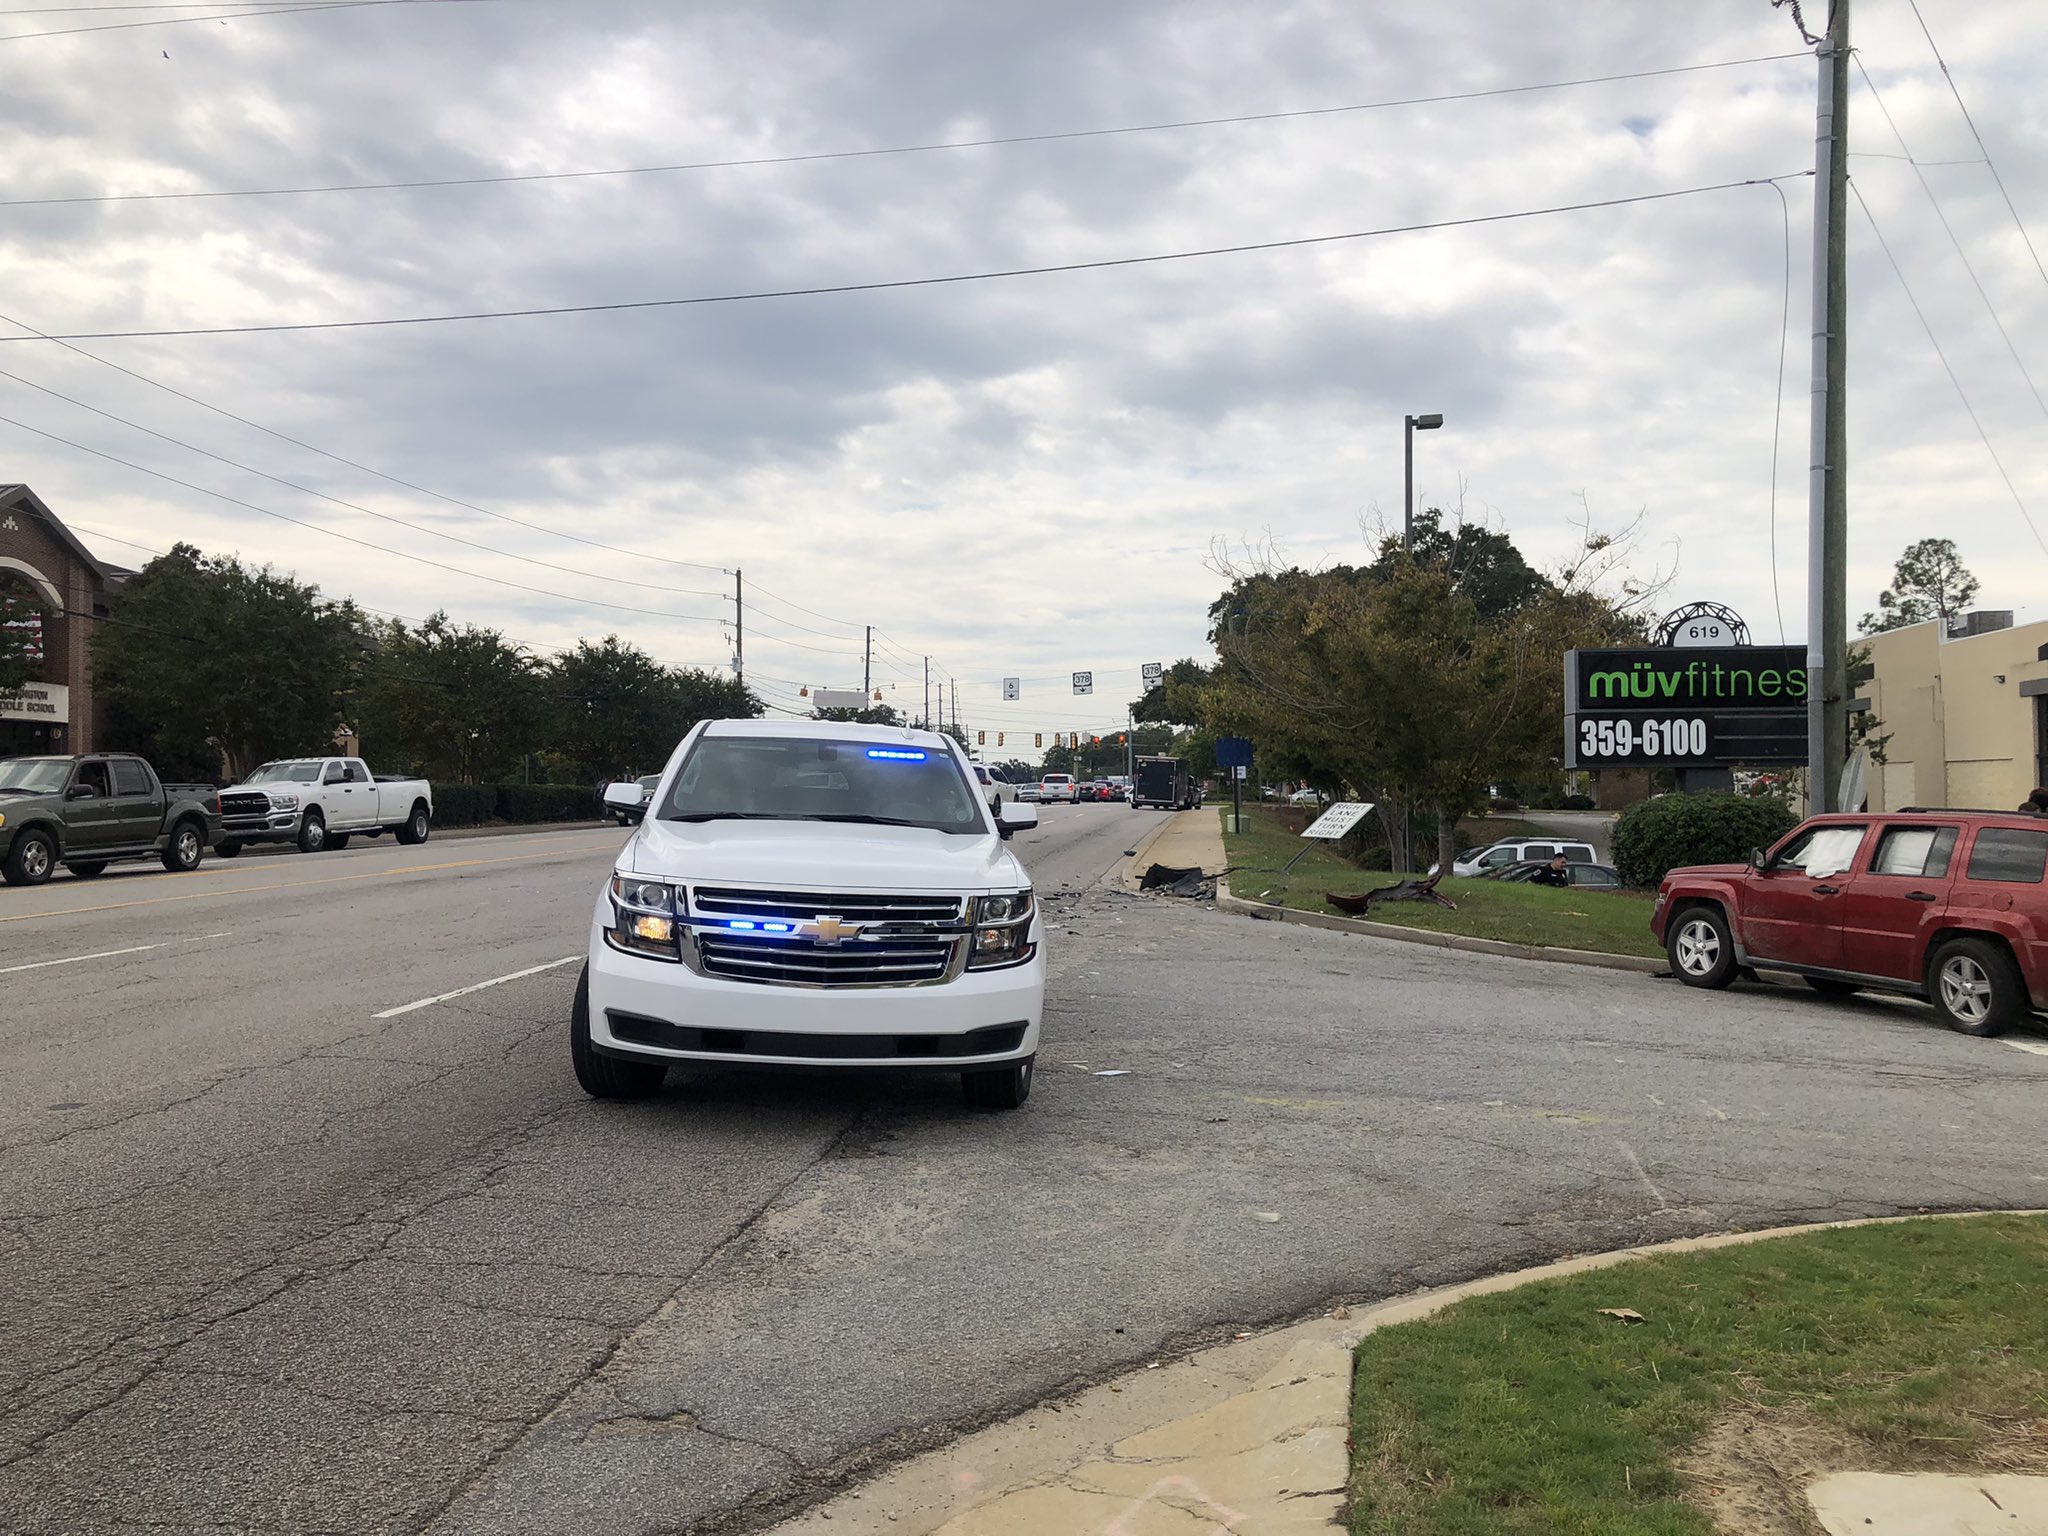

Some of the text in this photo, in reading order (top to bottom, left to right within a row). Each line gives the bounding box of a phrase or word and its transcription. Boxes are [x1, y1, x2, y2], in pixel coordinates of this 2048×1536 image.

[1689, 626, 1720, 639] 619
[1144, 667, 1160, 675] 378
[1075, 675, 1090, 684] 378
[1008, 682, 1014, 690] 6
[26, 702, 56, 713] SCHOOL
[1580, 718, 1707, 757] 359-6100
